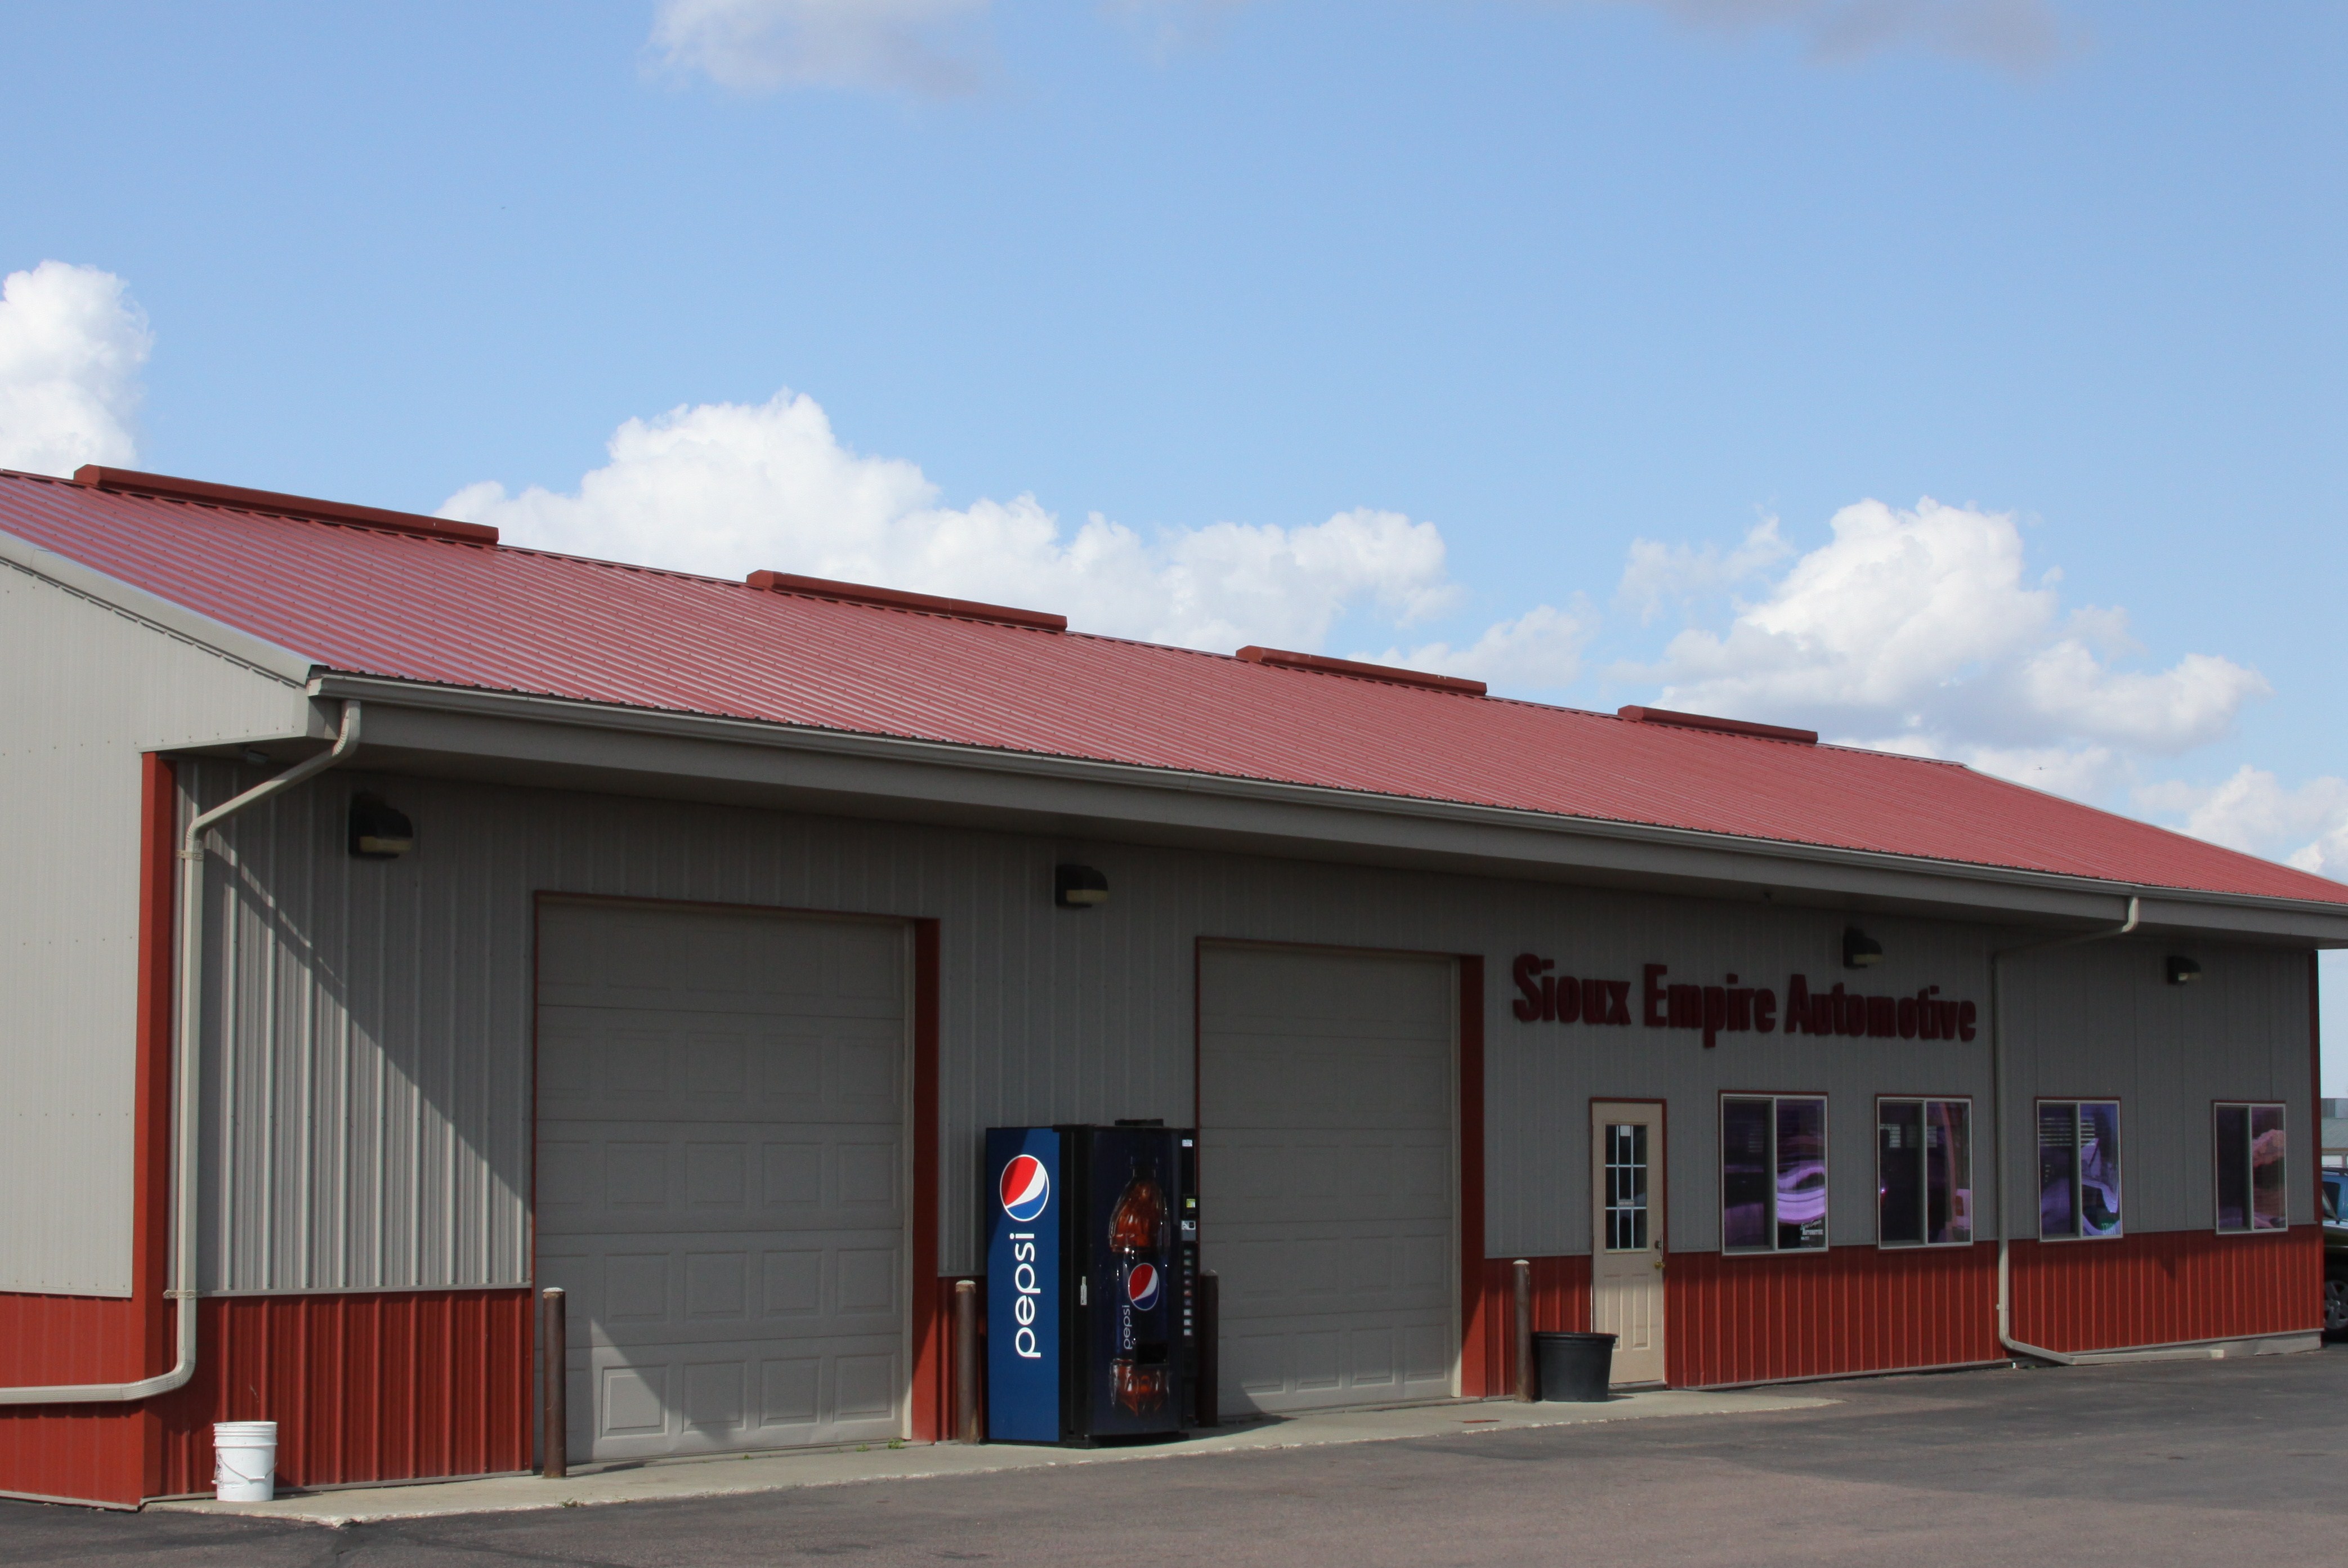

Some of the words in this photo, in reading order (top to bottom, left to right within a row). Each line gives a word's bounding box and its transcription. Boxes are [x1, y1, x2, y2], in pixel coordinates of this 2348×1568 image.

[1512, 953, 1632, 1025] Sioux
[1643, 963, 1777, 1049] Empire
[1785, 973, 1976, 1042] Automotive
[1009, 1233, 1041, 1358] pepsi
[1122, 1305, 1133, 1350] pepsi
